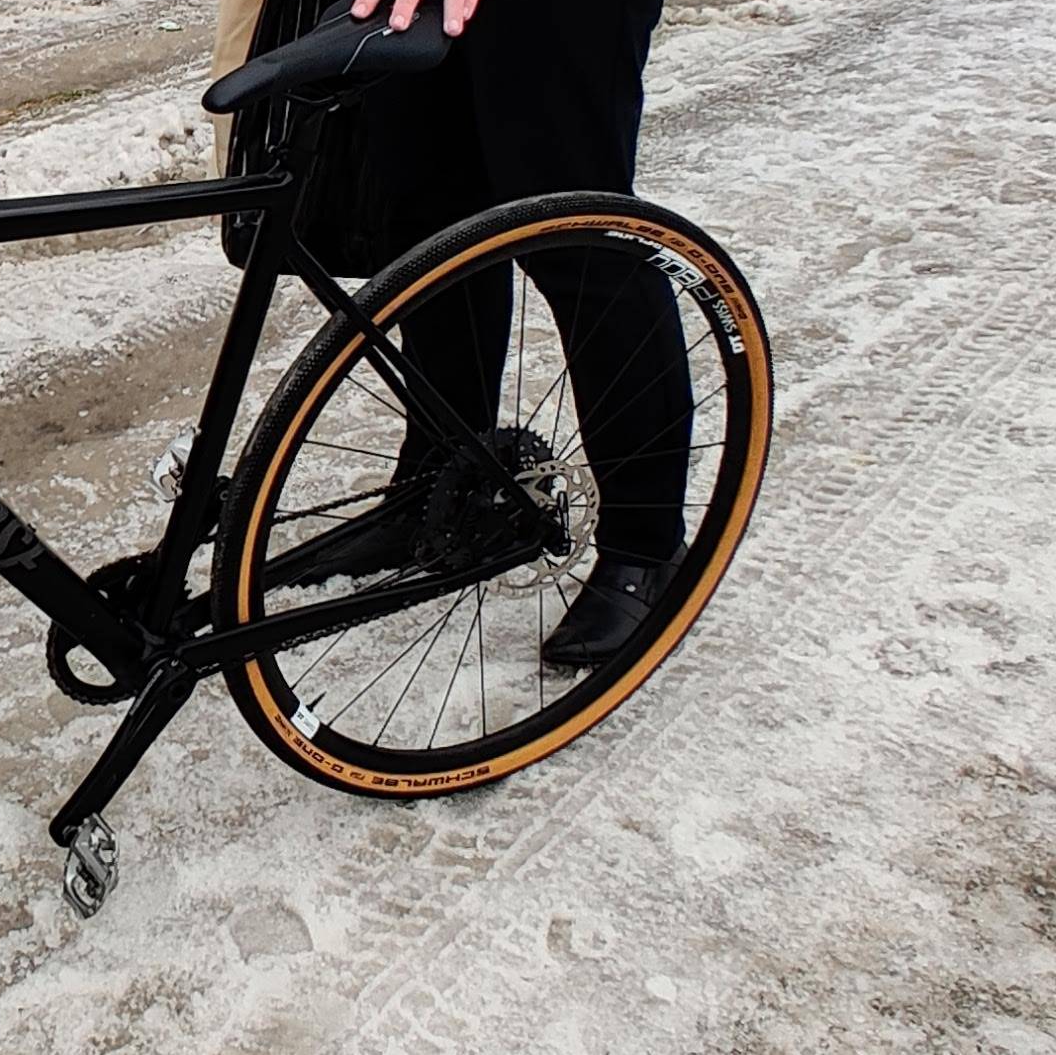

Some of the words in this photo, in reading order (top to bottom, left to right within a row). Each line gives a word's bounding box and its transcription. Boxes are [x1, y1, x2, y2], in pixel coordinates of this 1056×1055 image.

[712, 299, 738, 334] SWISS
[728, 335, 745, 355] DT
[371, 765, 490, 787] SCHWALBE
